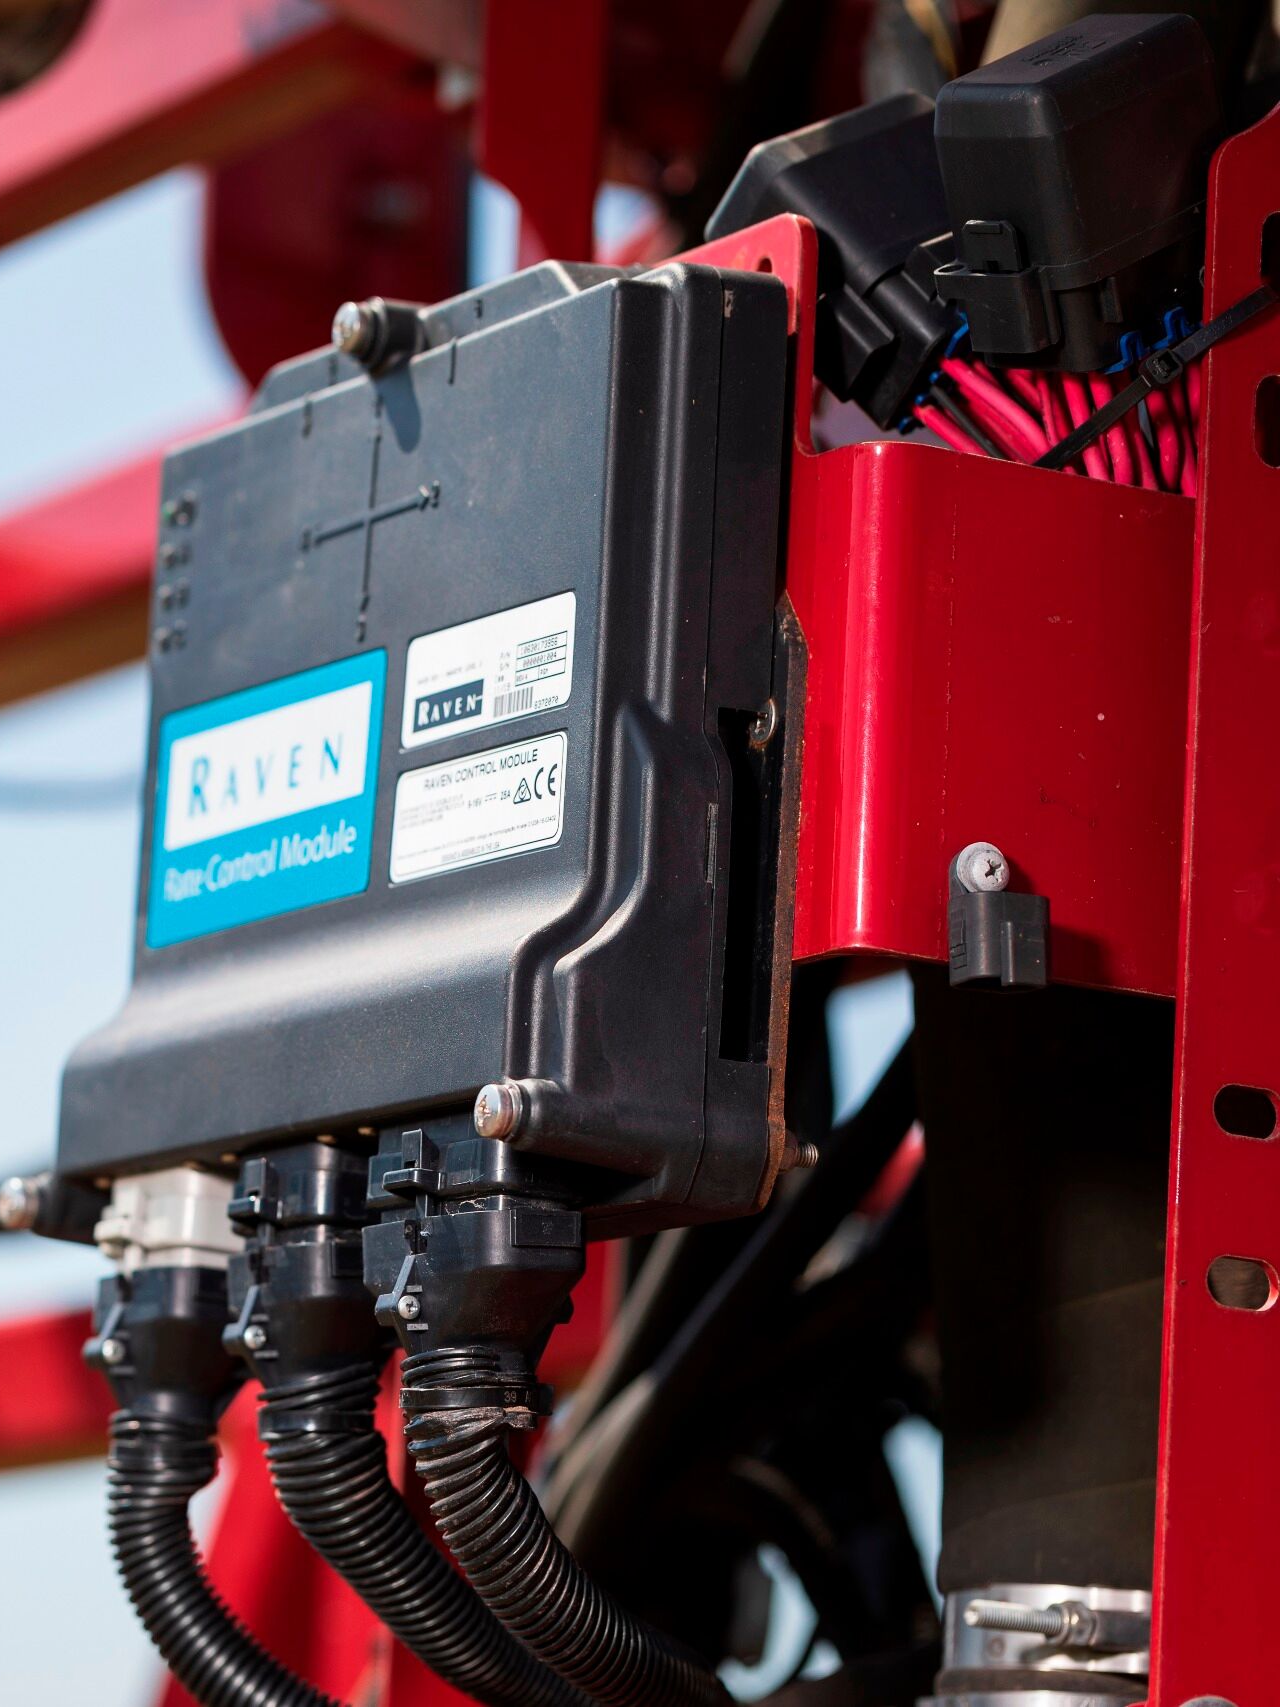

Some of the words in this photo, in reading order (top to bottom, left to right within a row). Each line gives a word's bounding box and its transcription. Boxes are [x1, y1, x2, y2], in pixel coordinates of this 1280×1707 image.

[417, 693, 478, 727] RAVEN
[186, 731, 344, 820] RAVEN
[423, 773, 454, 791] RAVEN
[454, 762, 498, 784] CONTROL
[499, 748, 539, 769] MODULE
[202, 836, 278, 892] Control
[279, 818, 357, 872] Module
